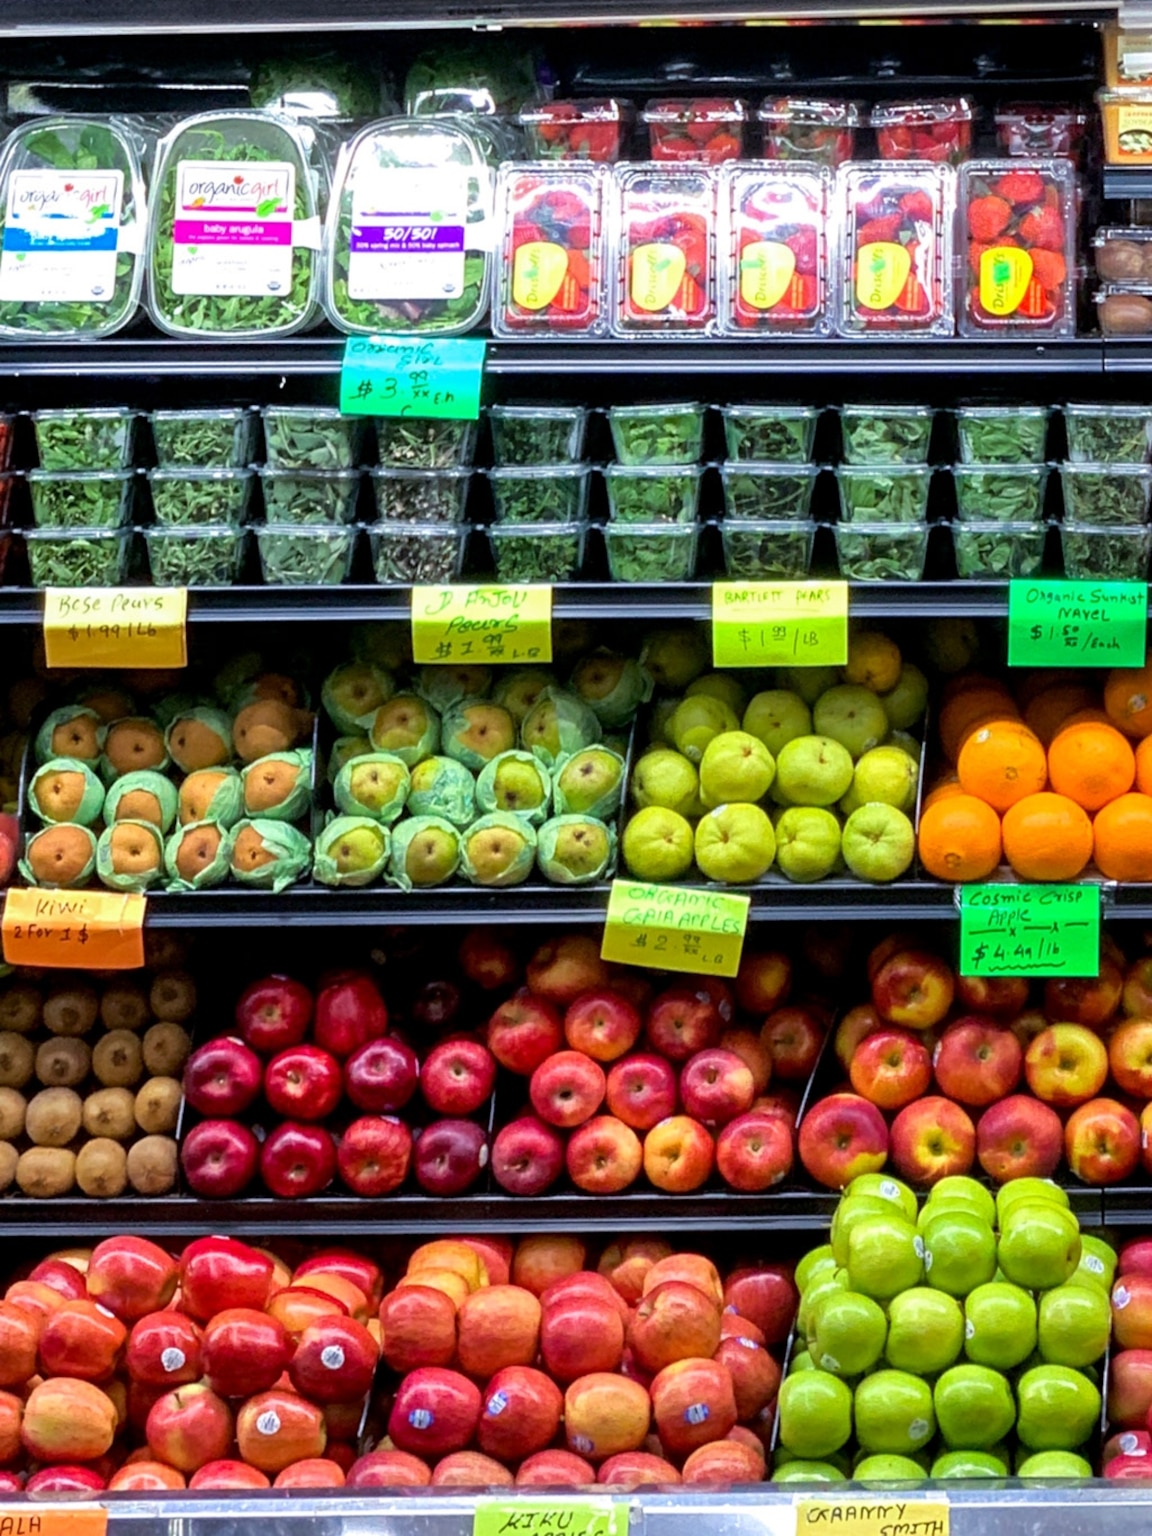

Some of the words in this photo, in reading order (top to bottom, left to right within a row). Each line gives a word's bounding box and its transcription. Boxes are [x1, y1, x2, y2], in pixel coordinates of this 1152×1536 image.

[204, 224, 227, 235] baby
[229, 224, 265, 236] arugula
[14, 926, 22, 939] 2
